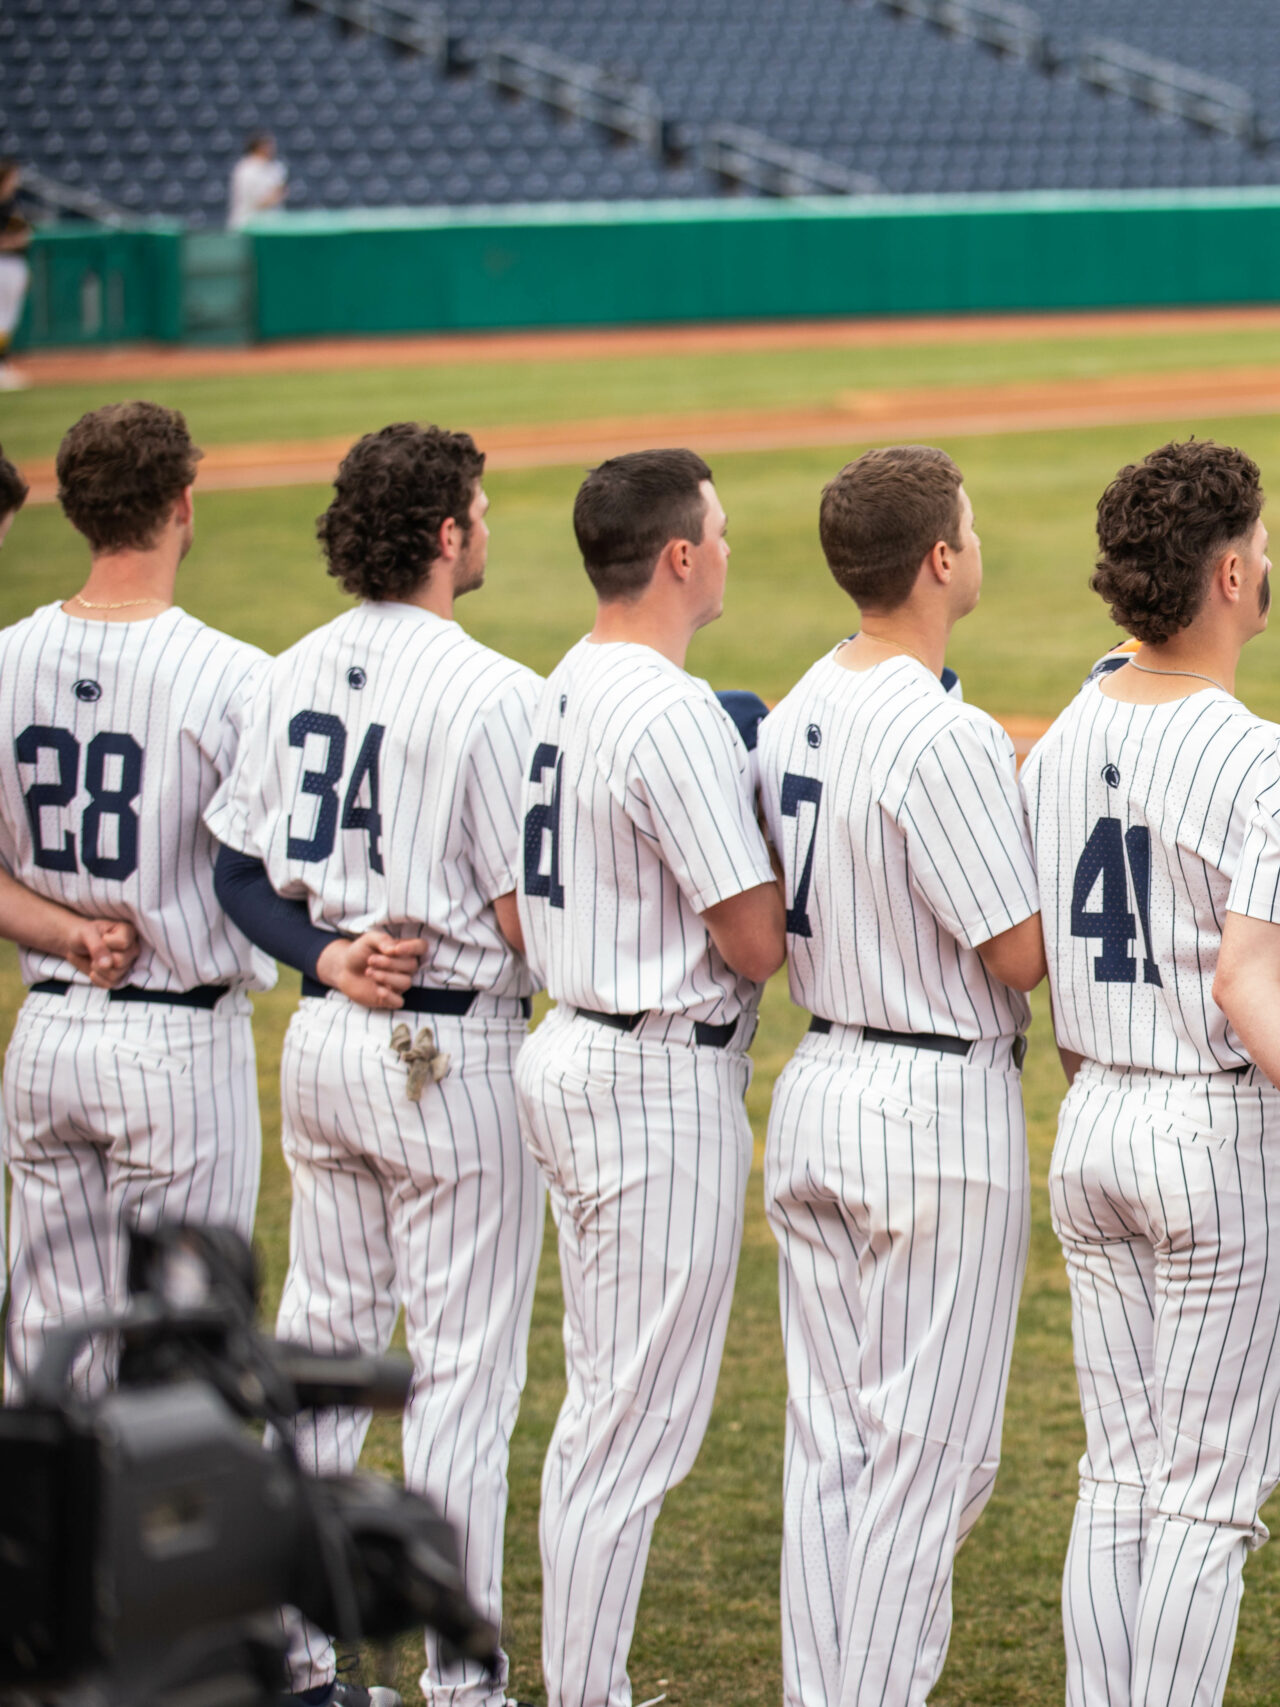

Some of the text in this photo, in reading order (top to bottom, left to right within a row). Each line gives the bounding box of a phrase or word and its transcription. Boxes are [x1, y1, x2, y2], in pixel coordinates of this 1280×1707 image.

[15, 724, 143, 881] 28
[287, 709, 386, 875] 34
[781, 772, 823, 938] 7
[1071, 817, 1164, 989] 41
